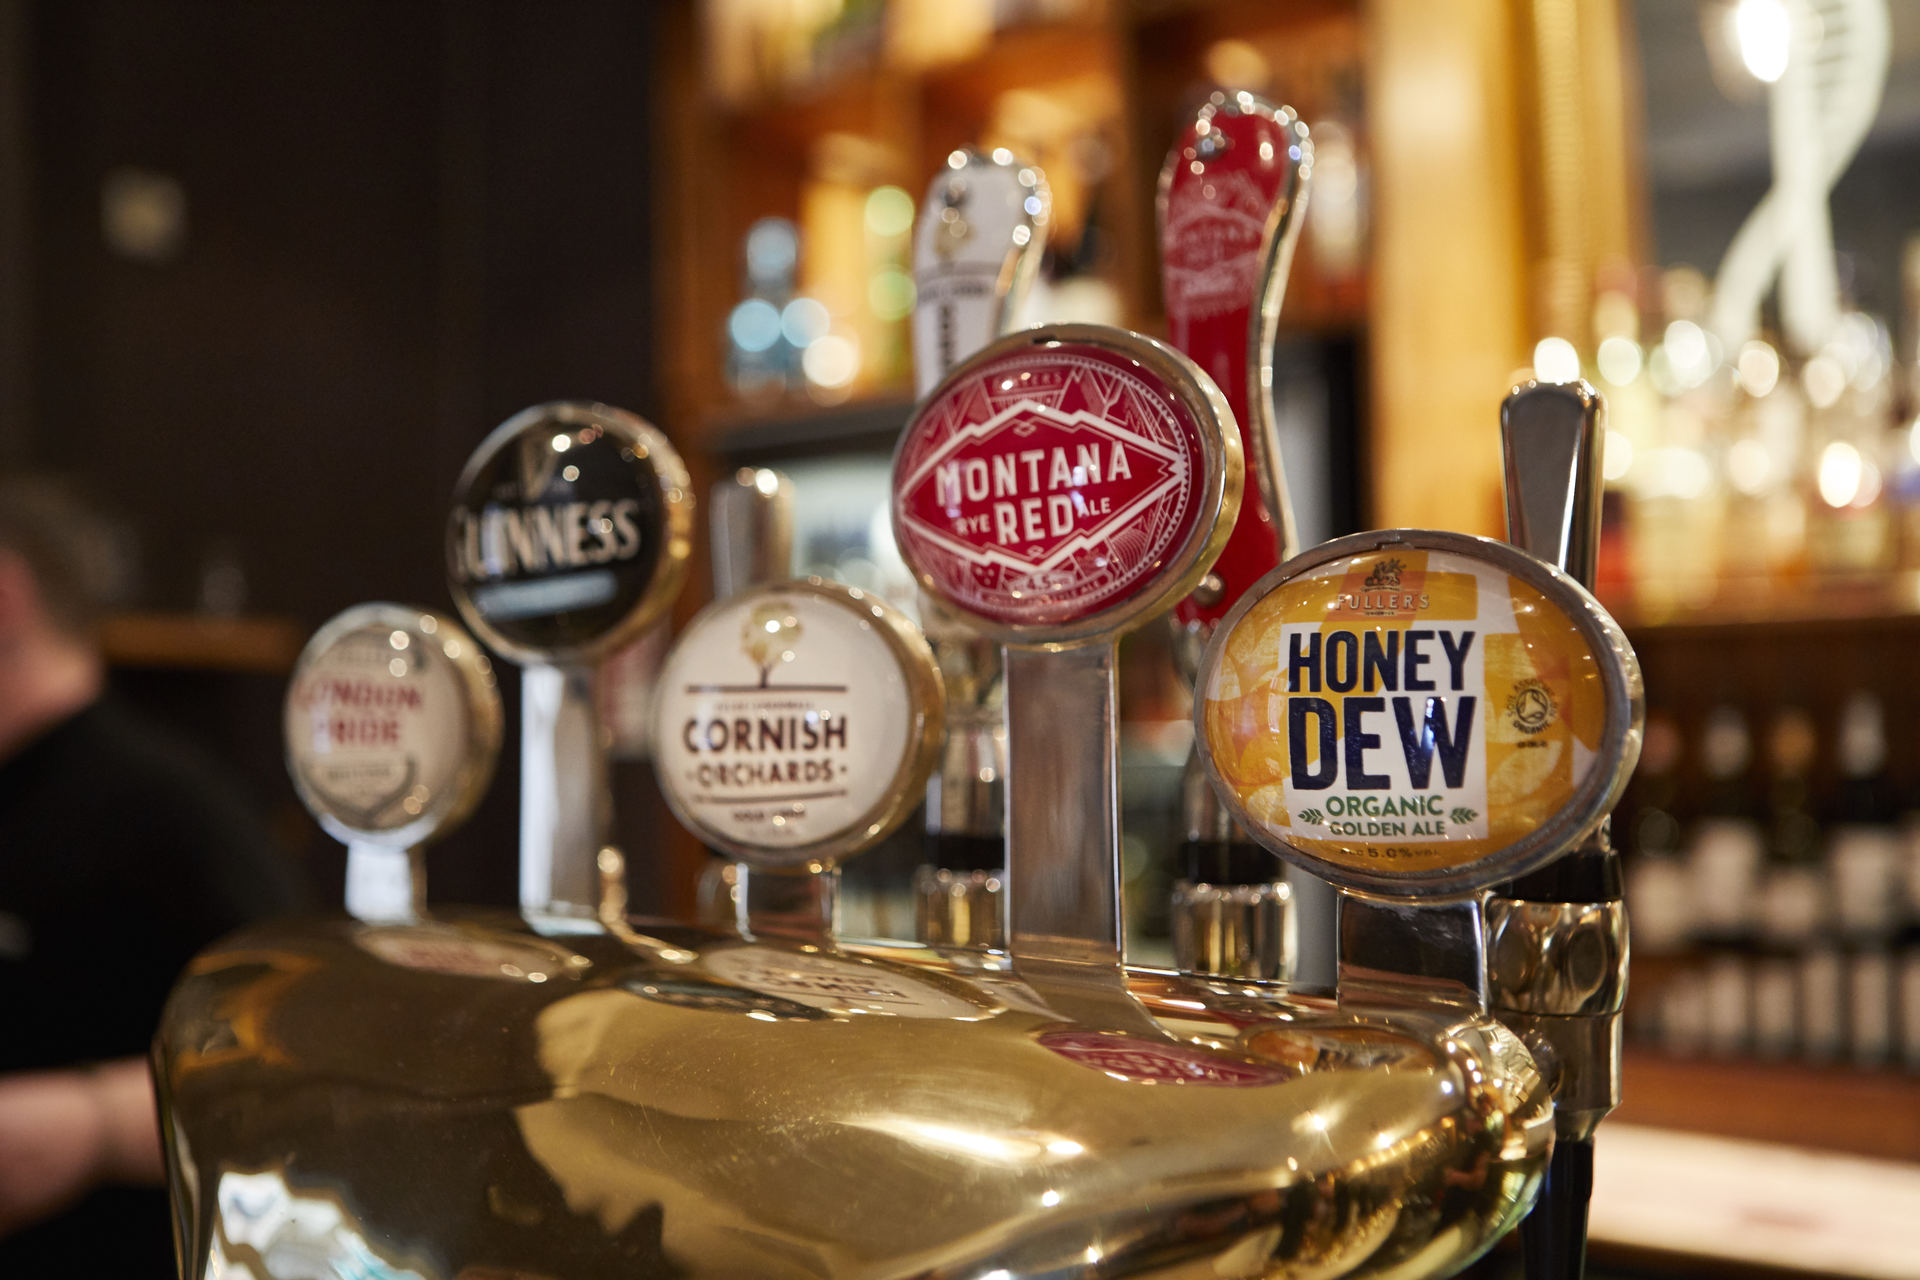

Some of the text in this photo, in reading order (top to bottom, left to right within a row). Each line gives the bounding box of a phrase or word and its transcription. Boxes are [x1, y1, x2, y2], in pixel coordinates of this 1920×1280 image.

[934, 441, 1132, 507] MONTANA
[955, 493, 1112, 546] RYE RED ALE
[1288, 630, 1476, 693] HONEY
[683, 714, 848, 755] CORNISH
[1288, 696, 1476, 791] DEW
[697, 758, 834, 788] ORCHARDS
[1325, 794, 1444, 817] ORGANIC
[1328, 820, 1446, 837] GOLDEN ALE
